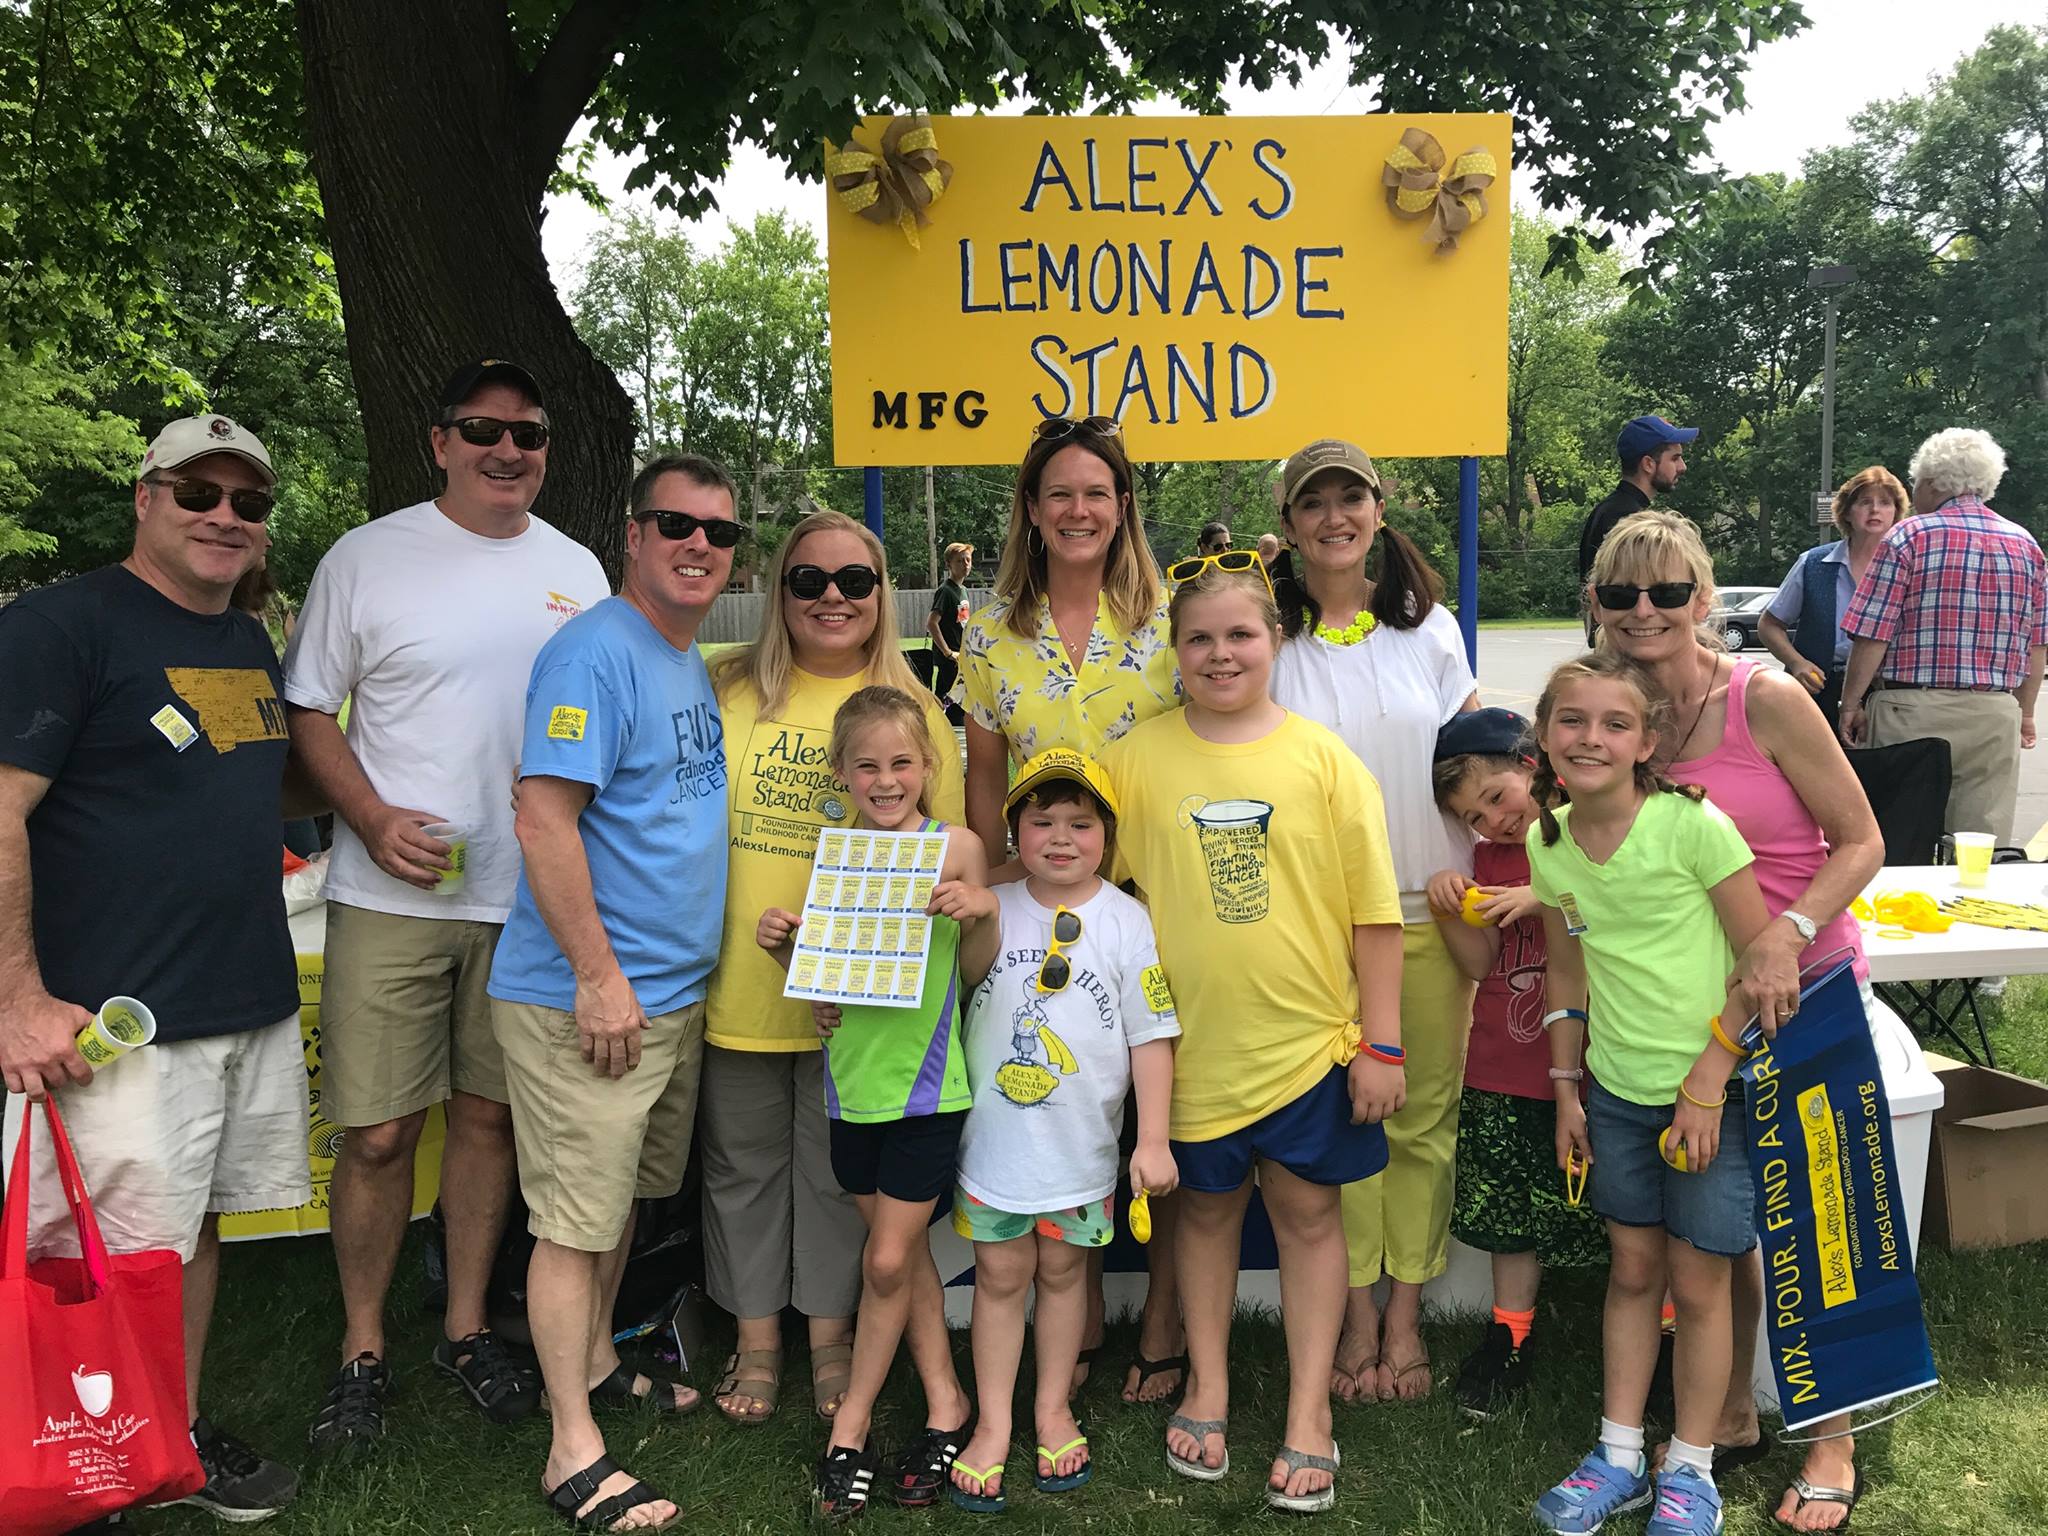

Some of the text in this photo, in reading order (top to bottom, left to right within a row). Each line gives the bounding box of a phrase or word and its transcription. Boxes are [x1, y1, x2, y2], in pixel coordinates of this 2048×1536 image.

[1019, 138, 1296, 221] ALEX'S
[958, 238, 1345, 320] LEMONADE
[1030, 333, 1277, 425] STAND
[872, 389, 989, 430] MFG
[672, 703, 724, 765] END
[750, 753, 851, 793] Lemonad
[752, 779, 813, 813] Stand
[755, 826, 799, 840] CHILDHOOD
[762, 818, 809, 832] FOUNDATION
[1200, 825, 1260, 836] EMPOWERED
[1210, 849, 1256, 869] FIGHTING
[1210, 860, 1265, 878] CHILDHOOD
[1219, 869, 1262, 885] CANCER
[1073, 968, 1114, 1030] HERO?
[1758, 1123, 1783, 1147] A
[1812, 1127, 1834, 1172] Stand
[1763, 1158, 1793, 1232] FIND
[1836, 1109, 1863, 1269] FOUNDATION FOR CHILDHOOD CANCER
[1858, 1080, 1900, 1271] AlexsLemonade.org
[1820, 1172, 1841, 1249] Lemonade
[1773, 1235, 1804, 1328] POUR.
[1781, 1332, 1819, 1405] MIX.
[43, 1411, 82, 1433] Apple
